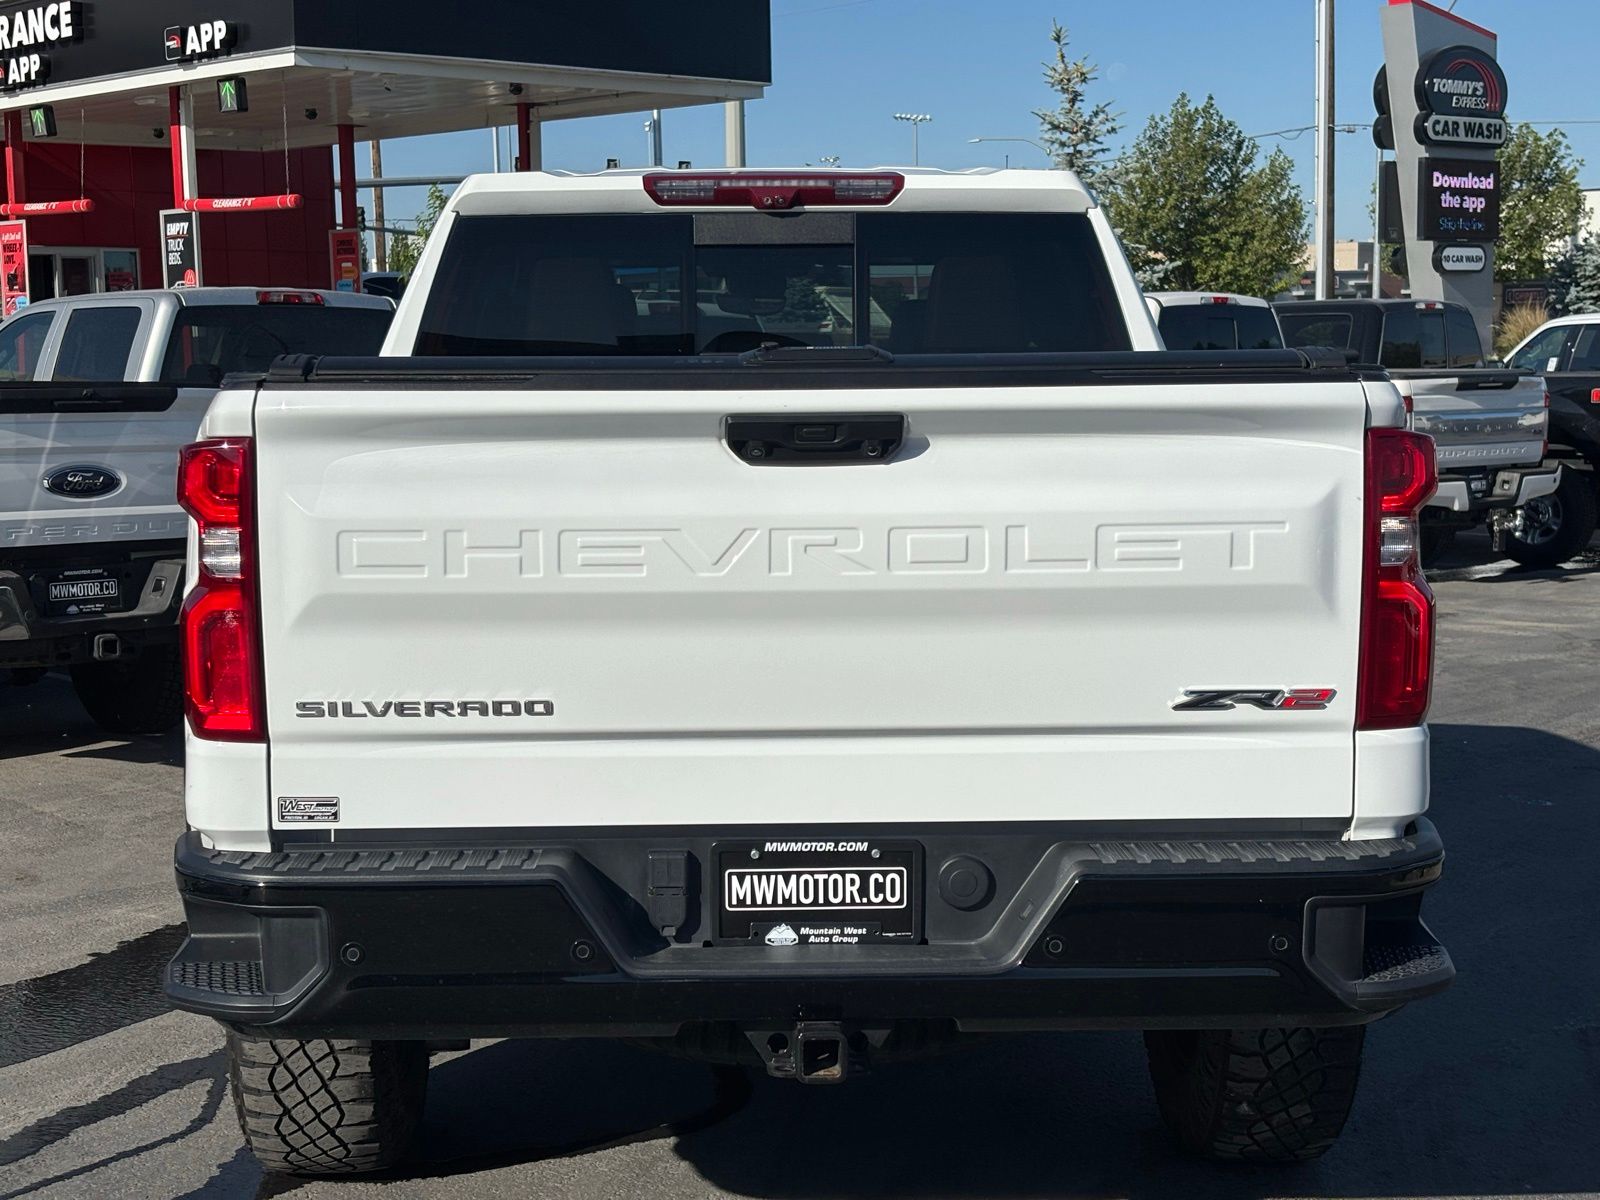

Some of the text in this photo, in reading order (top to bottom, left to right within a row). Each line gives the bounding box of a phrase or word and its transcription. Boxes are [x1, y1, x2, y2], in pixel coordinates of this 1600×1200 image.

[186, 20, 227, 55] APP
[8, 53, 41, 84] APP
[1433, 78, 1484, 96] TOMMY'S
[1452, 95, 1487, 109] EXPRESS
[1432, 119, 1503, 140] CAR WASH
[1432, 171, 1494, 189] Download
[1441, 191, 1486, 213] the app
[166, 222, 189, 236] EMPTY
[167, 238, 184, 252] TRUCK
[168, 252, 182, 265] BEDS.
[1451, 254, 1464, 263] CAR
[1465, 254, 1484, 263] WASH
[1490, 446, 1528, 457] DUTY
[336, 520, 1290, 579] CHEVROLET
[51, 581, 115, 599] MWMOTOR.CO
[295, 699, 555, 718] SILVERADO
[1171, 688, 1338, 712] ZR2
[764, 841, 869, 852] MWMOTOR.COM
[731, 872, 901, 905] MWMOTOR.CO
[800, 926, 867, 935] Mountain West
[808, 935, 859, 945] Auto Group
